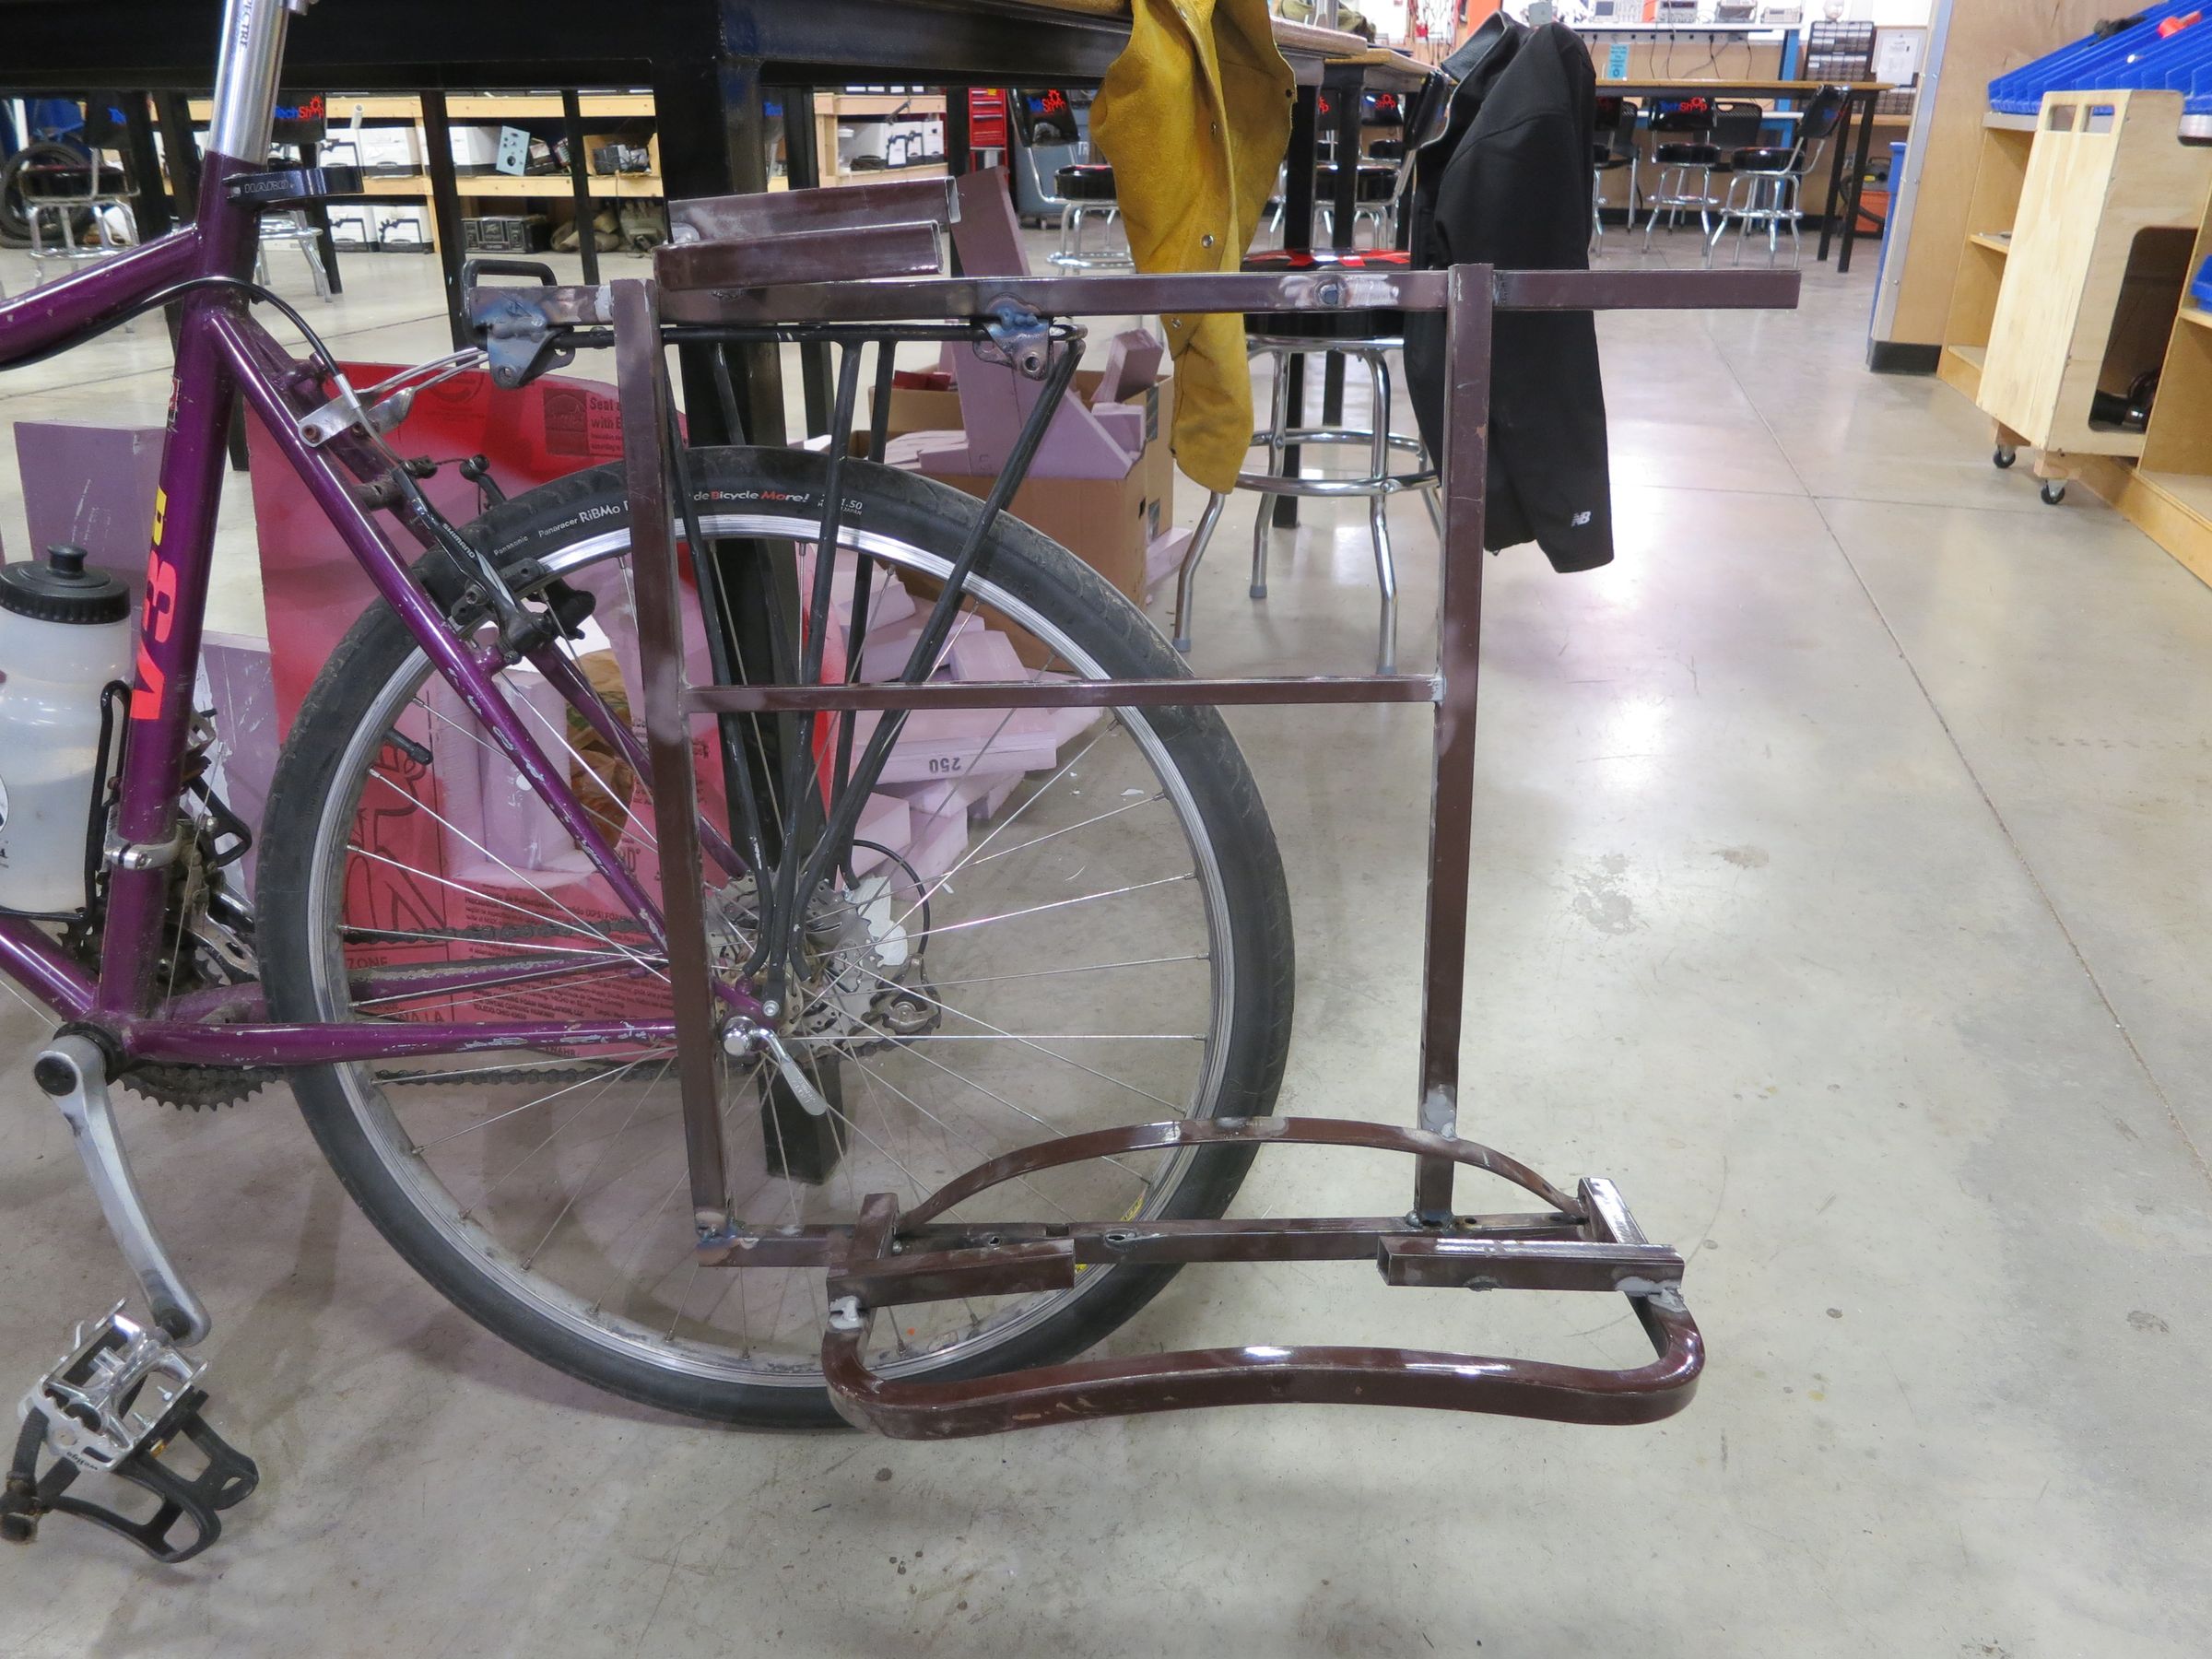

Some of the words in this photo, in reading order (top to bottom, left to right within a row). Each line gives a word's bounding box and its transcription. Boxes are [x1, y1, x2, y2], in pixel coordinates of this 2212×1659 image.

[711, 489, 759, 501] Bicycle
[760, 490, 810, 503] More!
[442, 523, 476, 559] SHIMANO
[493, 535, 529, 557] Panasonic
[538, 518, 579, 539] Panaracer
[929, 757, 961, 774] 250
